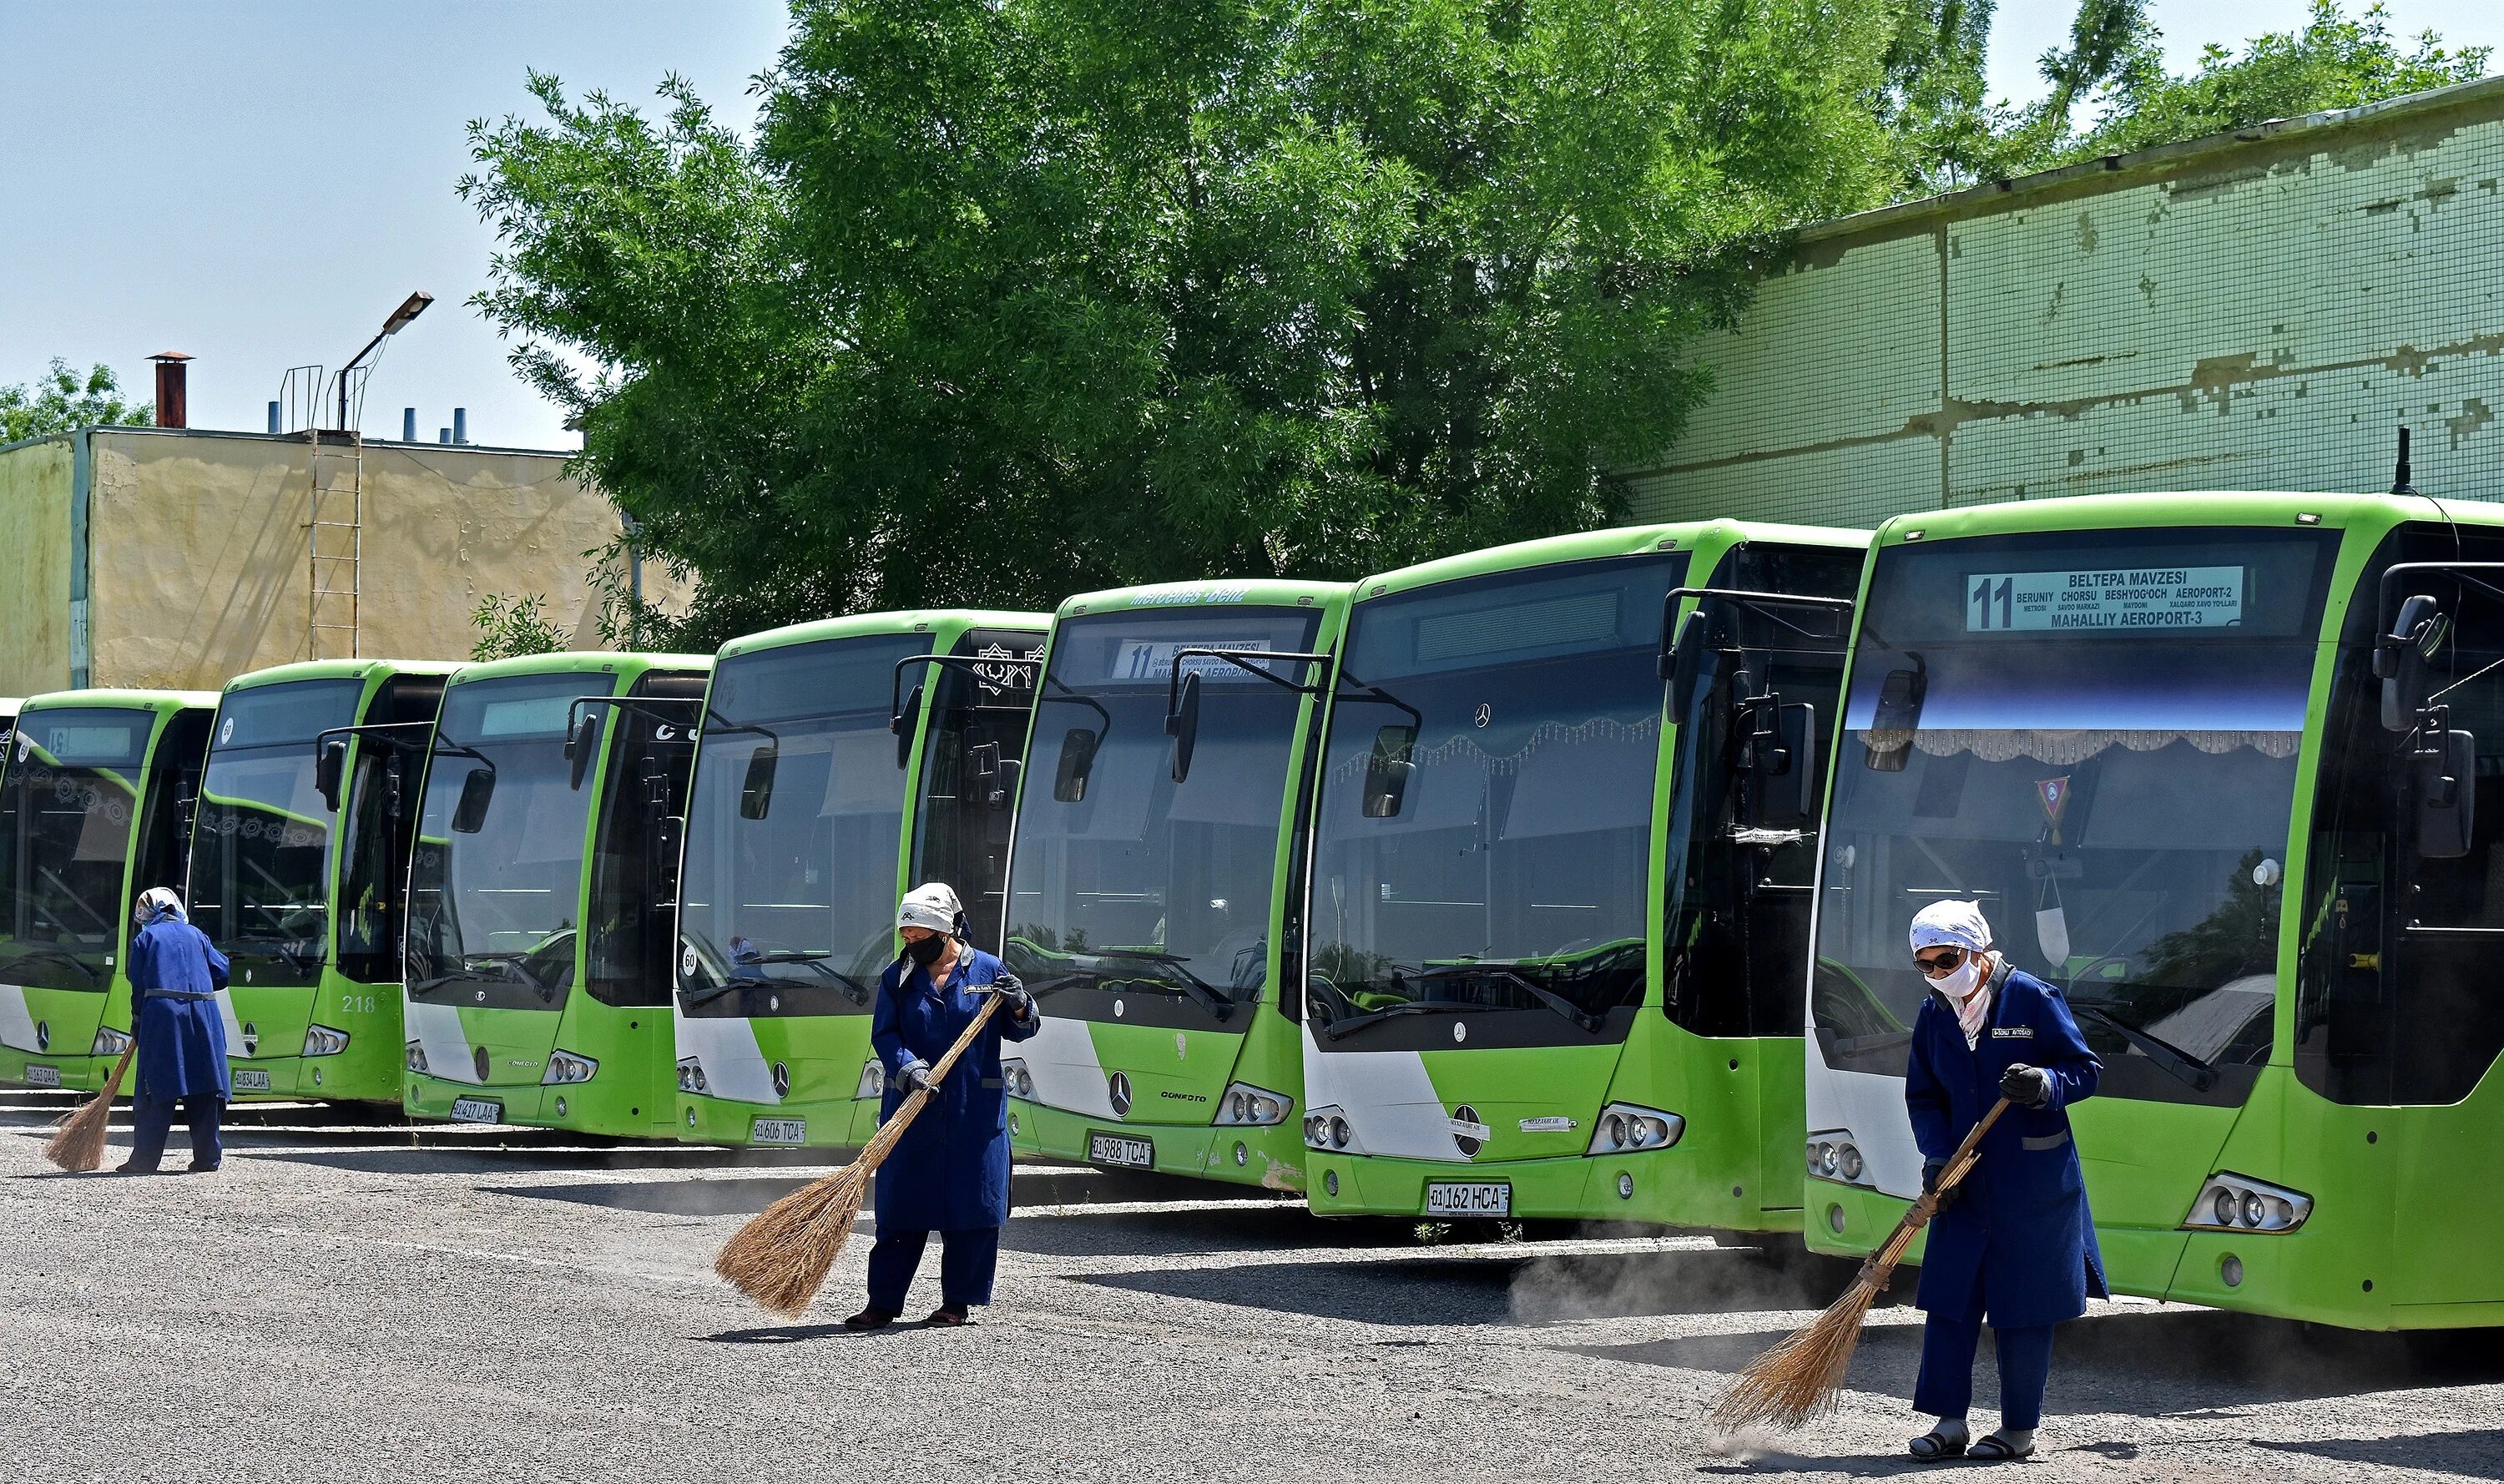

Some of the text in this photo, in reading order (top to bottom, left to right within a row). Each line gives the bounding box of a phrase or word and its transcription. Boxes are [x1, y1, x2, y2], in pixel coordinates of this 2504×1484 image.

[2069, 571, 2187, 588] BELTEPA MAVZESI
[1972, 577, 2013, 629] 11
[2017, 592, 2054, 603] BERUNIY
[2061, 590, 2097, 602] CHORSU
[2175, 587, 2232, 598] AEROPORT-2
[2051, 611, 2203, 628] MAHALLIY AEROPORT-3
[1128, 644, 1154, 679] 11
[685, 954, 694, 967] 60
[342, 996, 375, 1013] 218
[1160, 1091, 1207, 1103] CONECTO
[462, 1103, 477, 1118] 417
[477, 1104, 493, 1121] LAA
[765, 1122, 780, 1139] 606
[783, 1123, 799, 1141] TCA
[1093, 1138, 1146, 1163] 01 988 TCA
[1431, 1189, 1443, 1206] 01
[1445, 1187, 1469, 1209] 162
[1472, 1187, 1499, 1209] HCA
